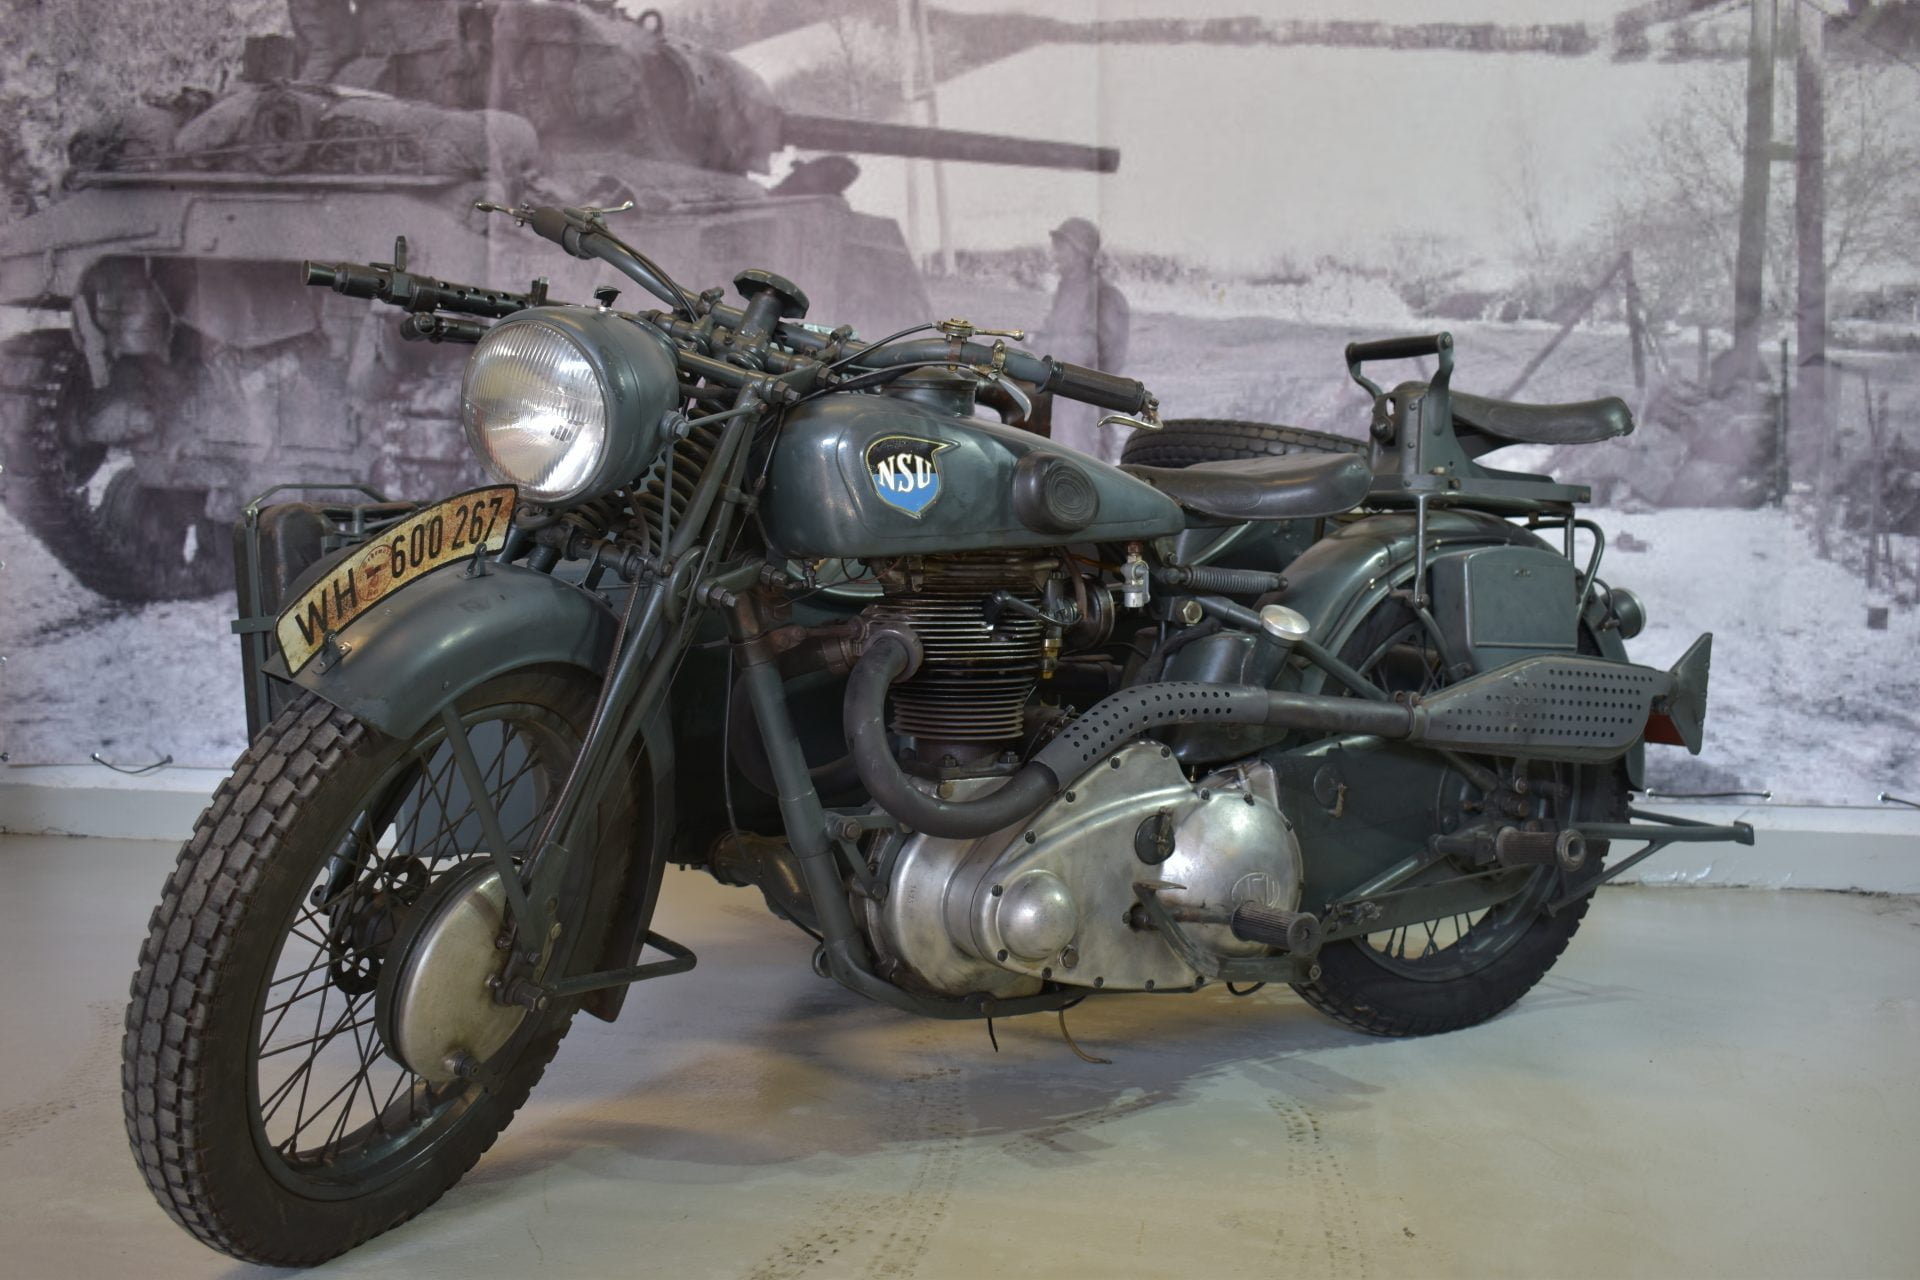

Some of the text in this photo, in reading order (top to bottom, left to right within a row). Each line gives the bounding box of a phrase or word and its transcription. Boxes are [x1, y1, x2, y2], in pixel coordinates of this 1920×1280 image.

[878, 453, 932, 493] NSU
[294, 567, 357, 646] WH
[391, 515, 444, 578] 600
[452, 497, 504, 550] 267
